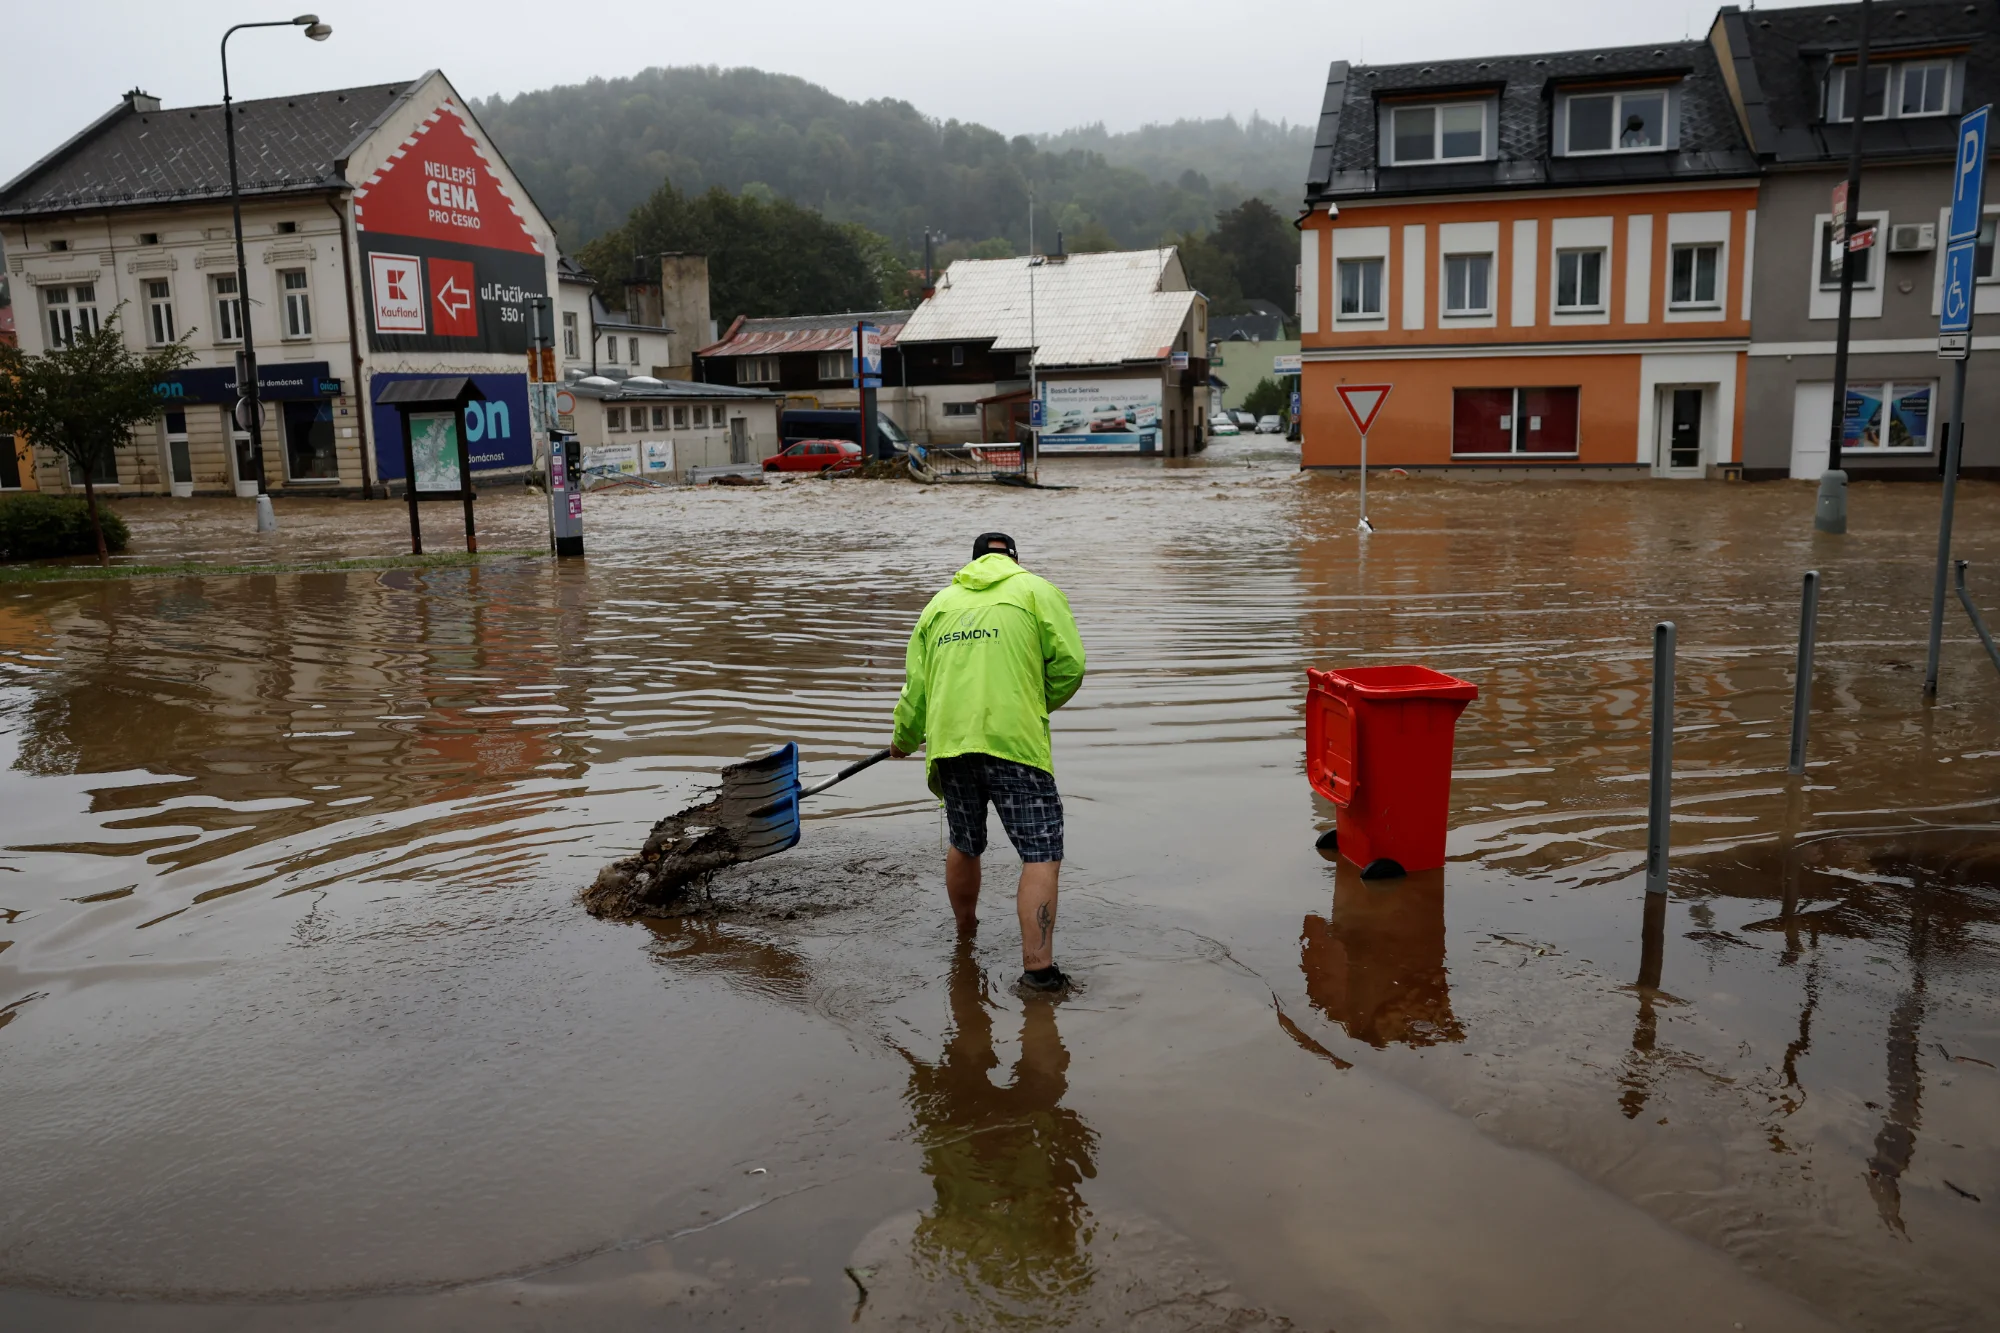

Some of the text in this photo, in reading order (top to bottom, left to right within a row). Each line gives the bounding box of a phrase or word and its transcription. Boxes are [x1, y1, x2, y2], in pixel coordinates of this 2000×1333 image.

[424, 160, 476, 186] NEJLEPŠÍ
[1959, 129, 1978, 201] P
[427, 180, 479, 213] CENA
[428, 209, 480, 229] PRO ČESKO
[381, 306, 418, 318] Kaufland
[500, 307, 519, 322] 350
[266, 379, 303, 387] domácnost
[319, 380, 339, 391] orion
[1032, 402, 1040, 419] P
[553, 441, 560, 453] P
[937, 628, 999, 647] ASSMONT
